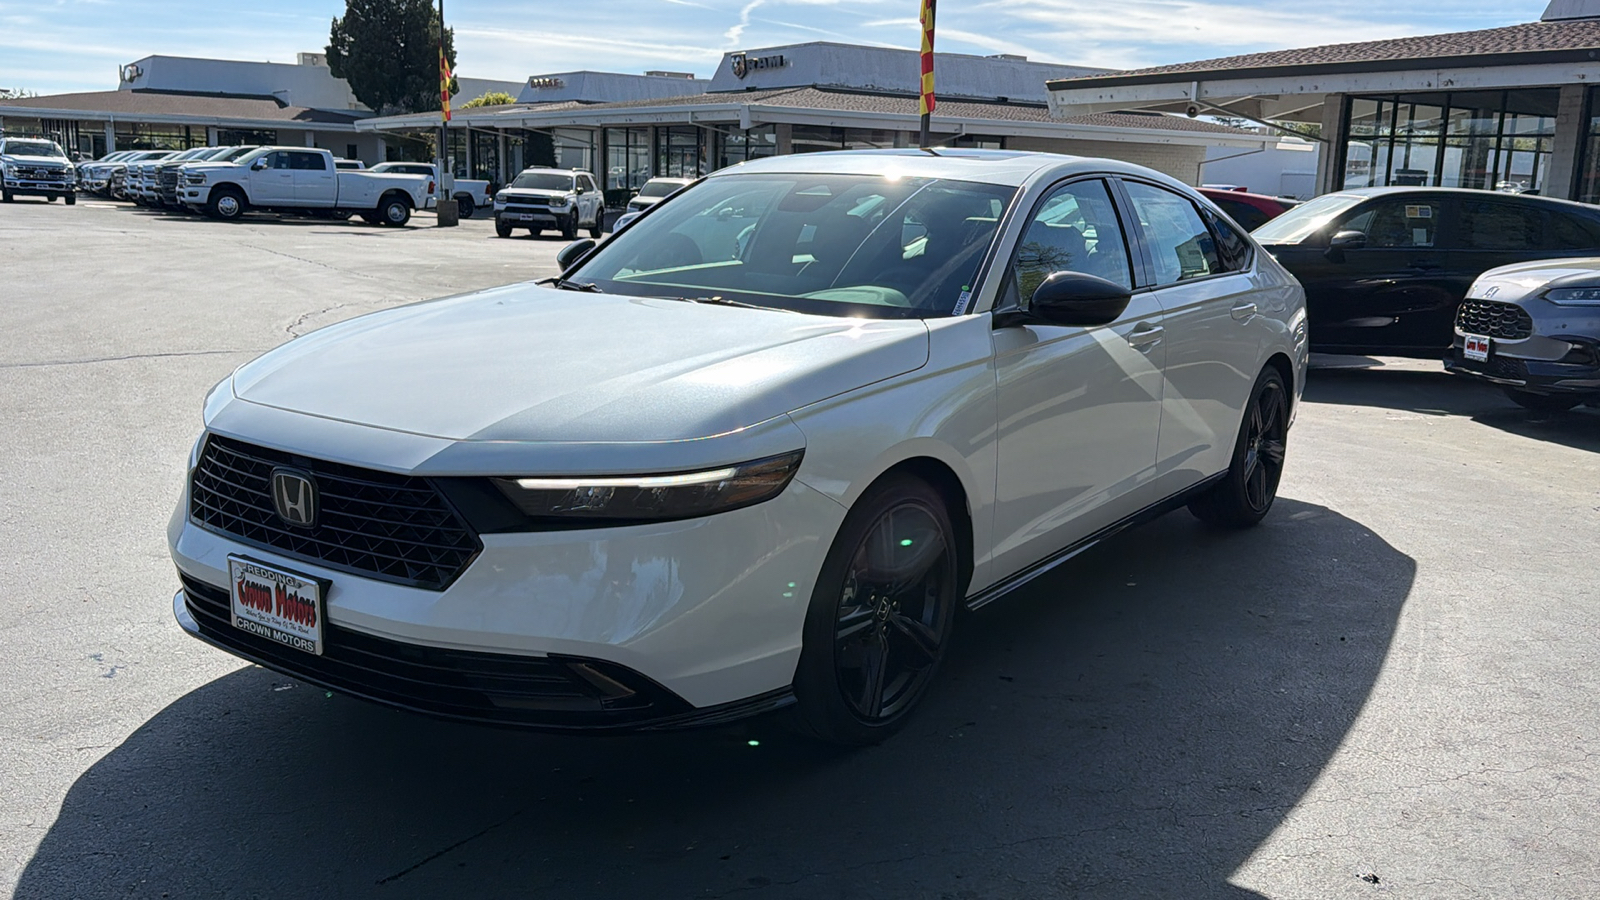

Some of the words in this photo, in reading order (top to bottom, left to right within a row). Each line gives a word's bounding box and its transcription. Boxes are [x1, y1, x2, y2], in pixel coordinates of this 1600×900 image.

[746, 55, 784, 71] RAM
[247, 565, 294, 586] REDDING
[237, 573, 273, 614] Crown
[275, 582, 317, 628] Motors
[237, 618, 271, 637] CROWN
[273, 630, 314, 652] MOTORS
[271, 616, 282, 627] King
[282, 619, 289, 628] Of
[289, 621, 298, 630] The
[298, 625, 309, 635] Road
